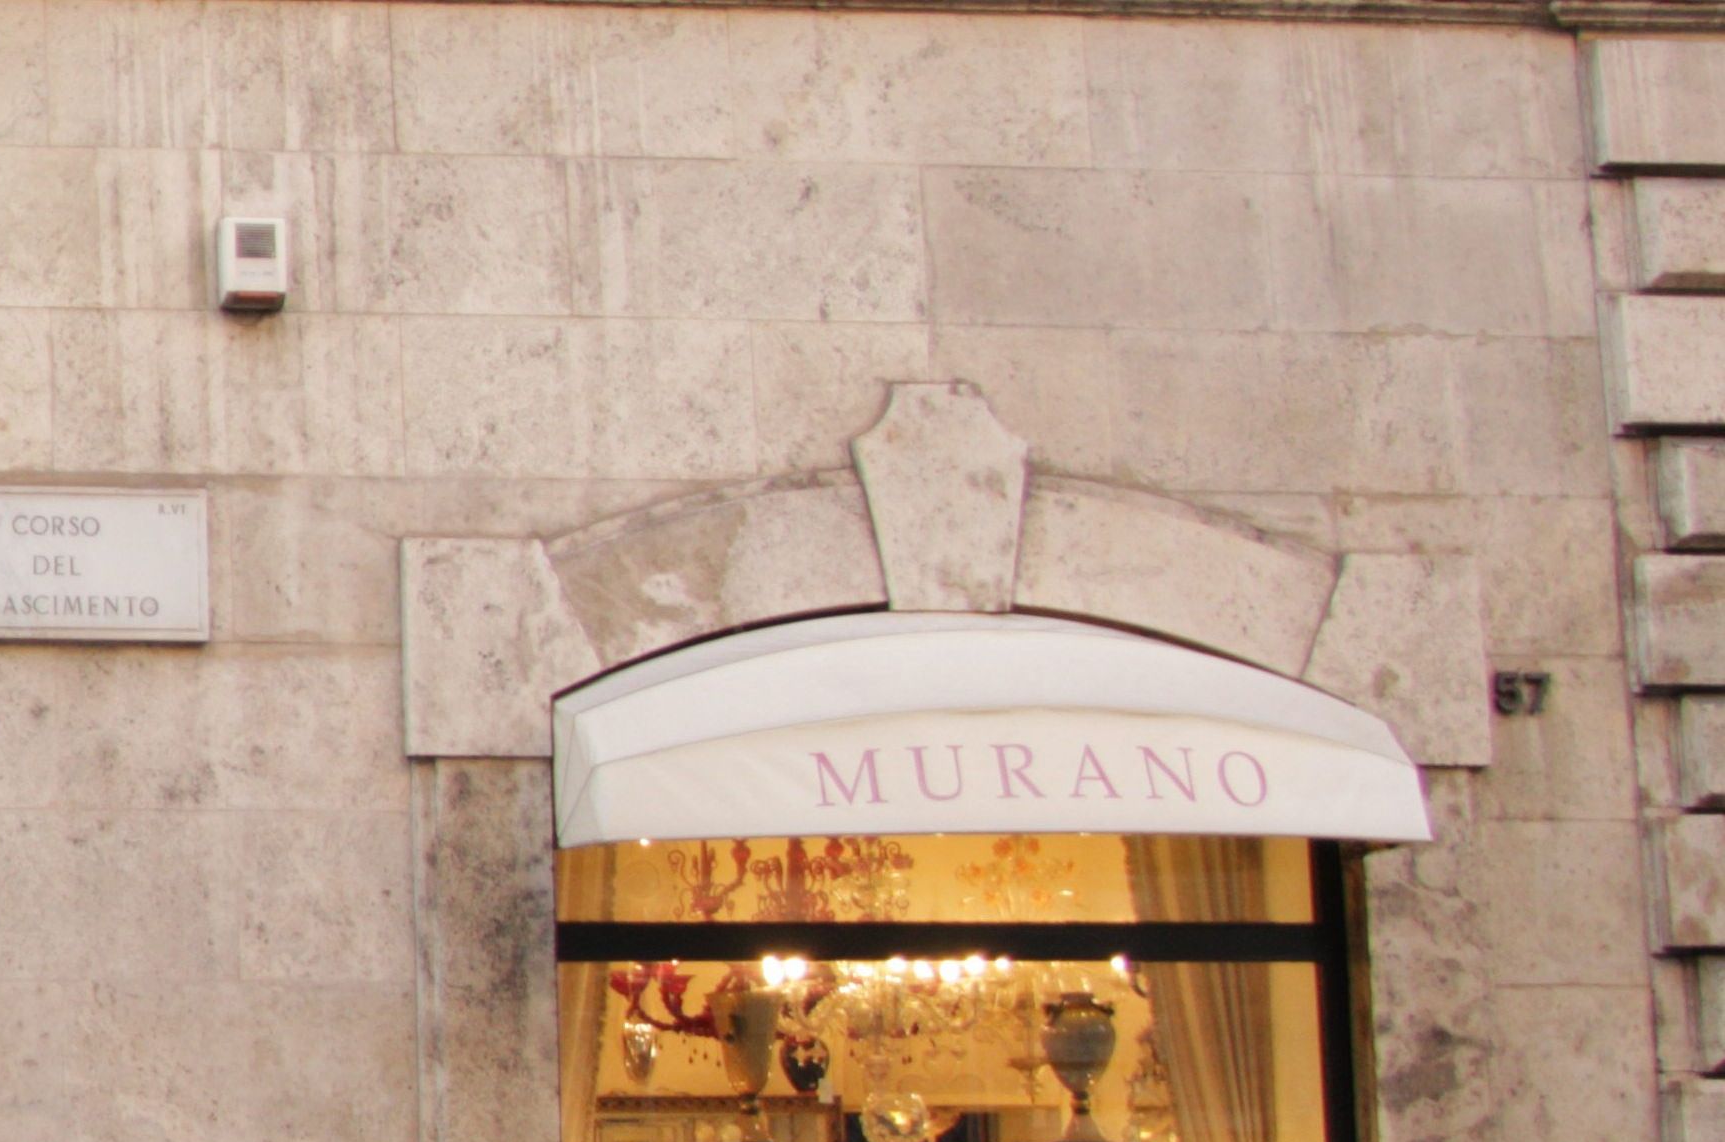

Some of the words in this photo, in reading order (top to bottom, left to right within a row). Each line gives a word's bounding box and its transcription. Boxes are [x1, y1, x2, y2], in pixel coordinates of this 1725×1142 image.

[11, 514, 101, 538] CORSO
[32, 554, 82, 577] DEL
[1495, 671, 1550, 717] 57
[809, 742, 1269, 808] MURANO
